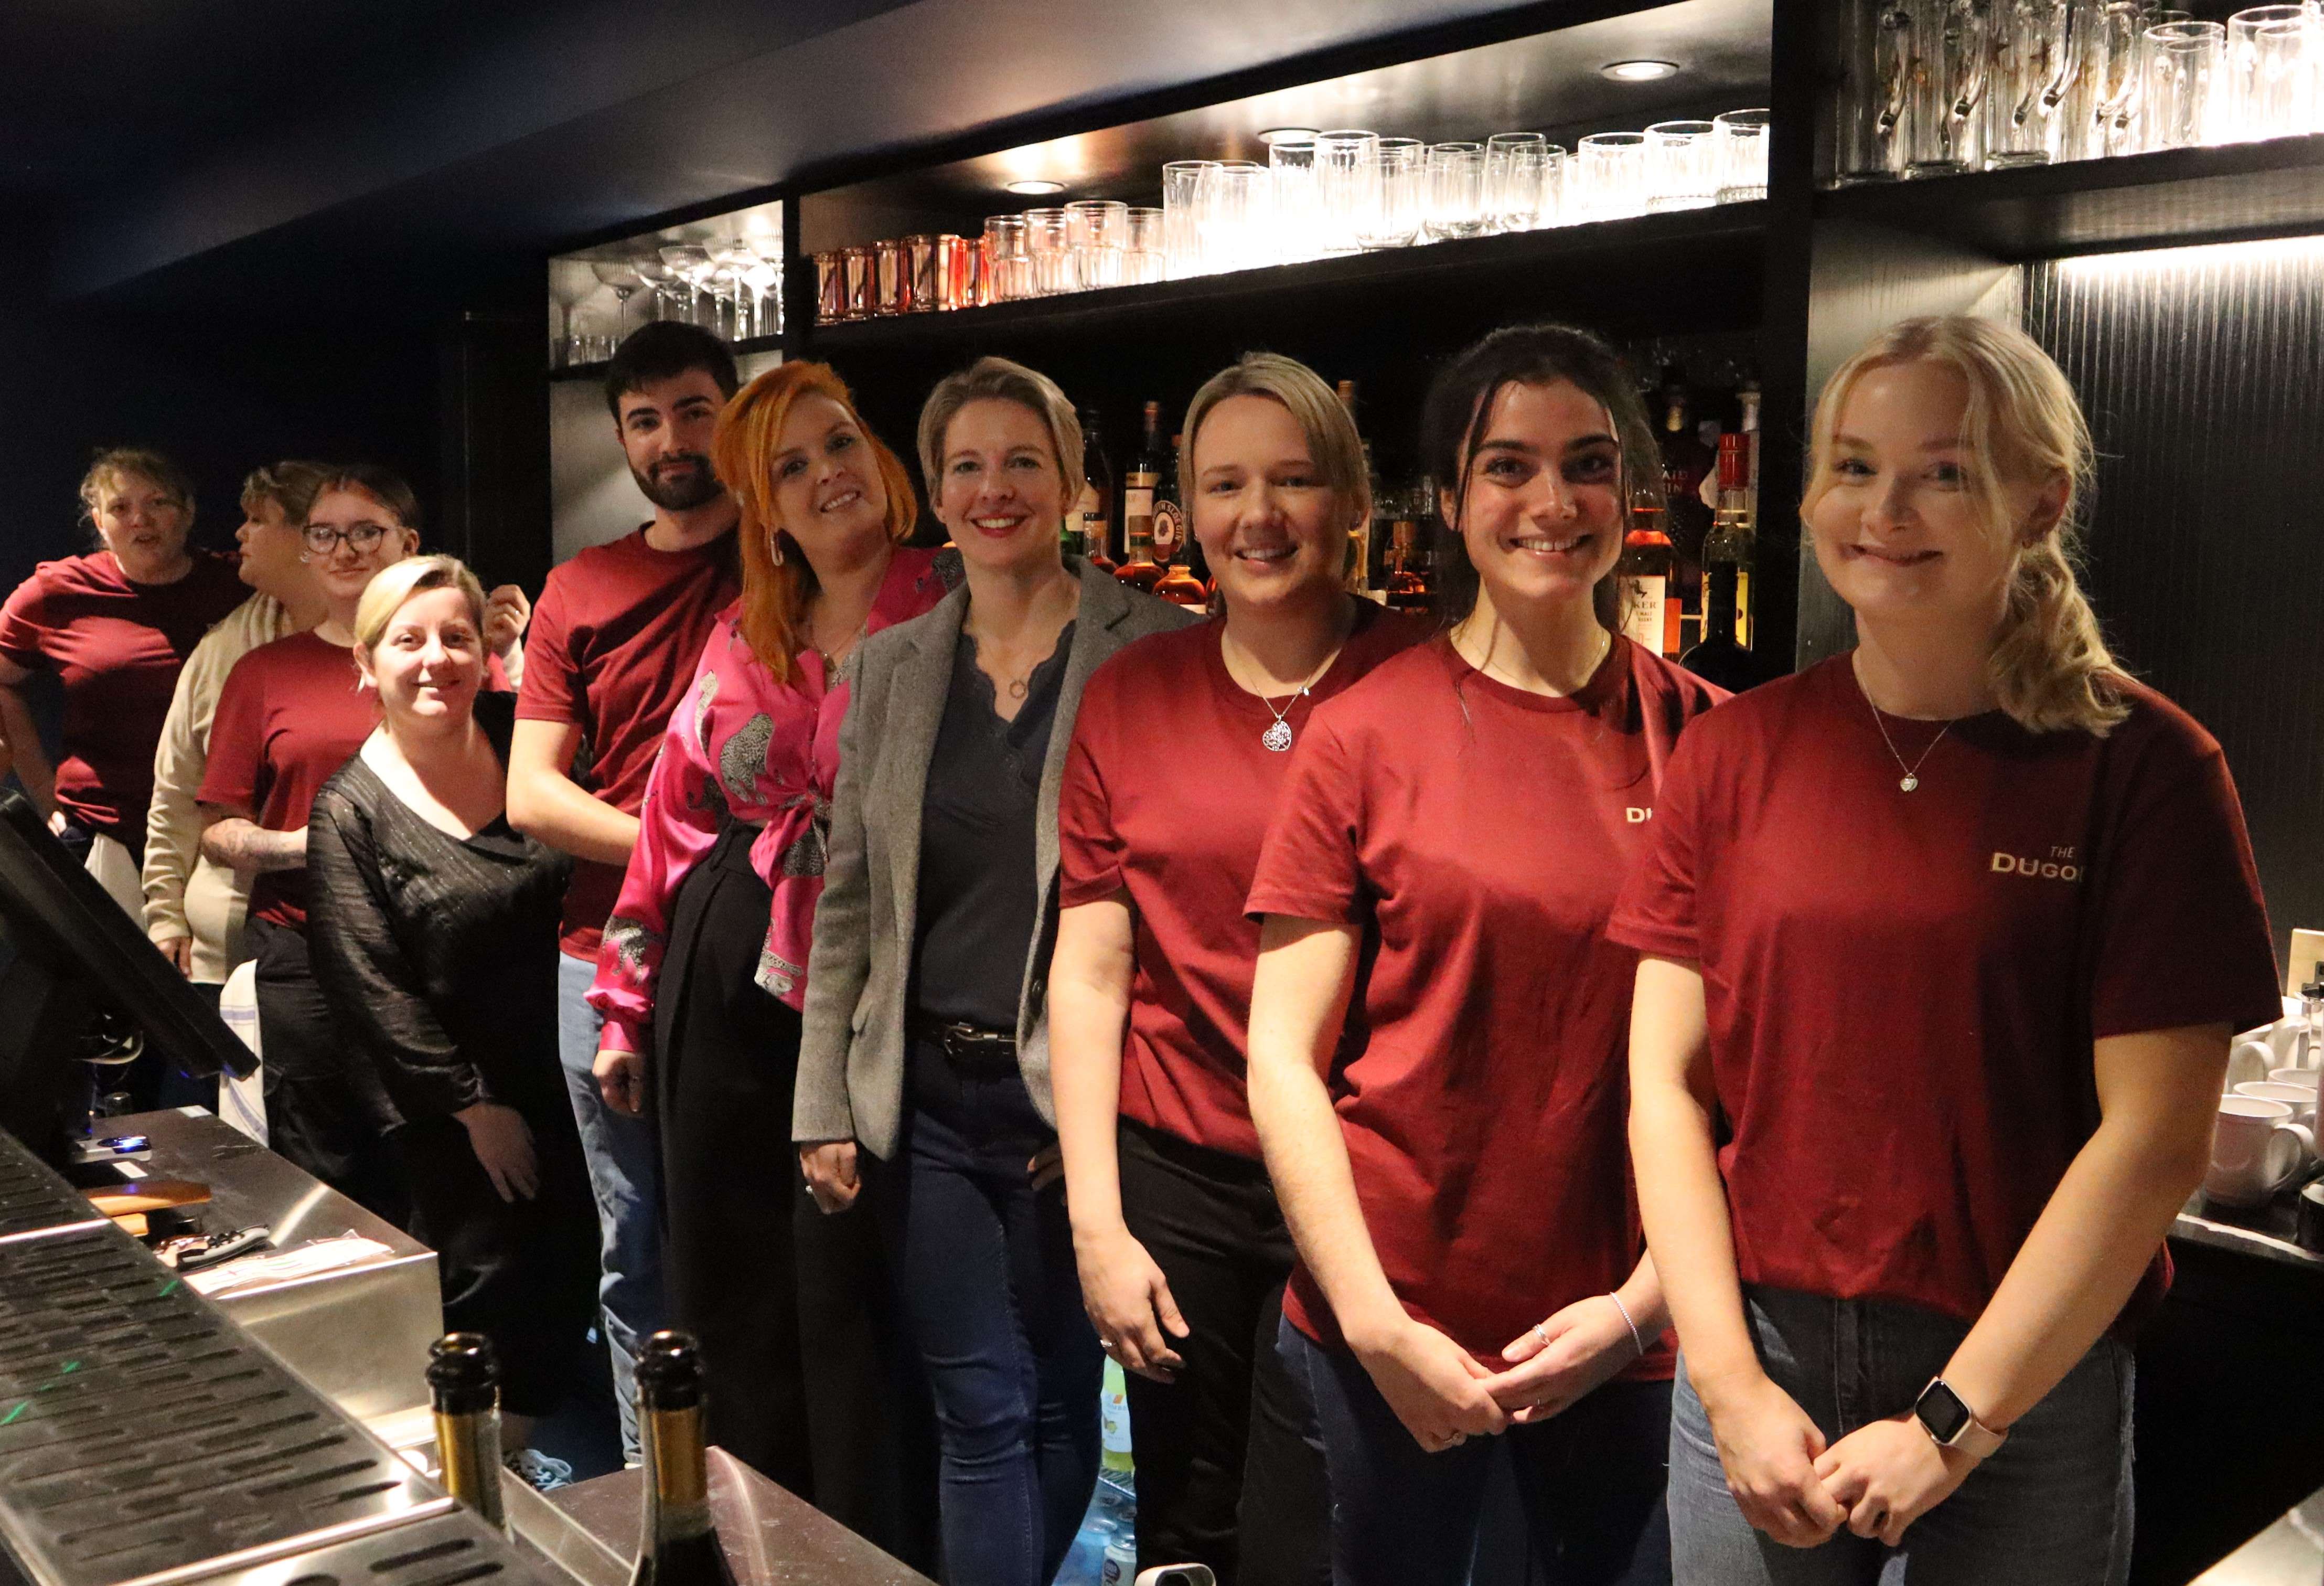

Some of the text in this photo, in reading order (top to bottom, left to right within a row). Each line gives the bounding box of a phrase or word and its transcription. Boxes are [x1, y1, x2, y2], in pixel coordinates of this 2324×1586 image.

[1166, 505, 1181, 524] SLOE
[2051, 846, 2075, 858] THE
[1991, 852, 2083, 882] DUGO
